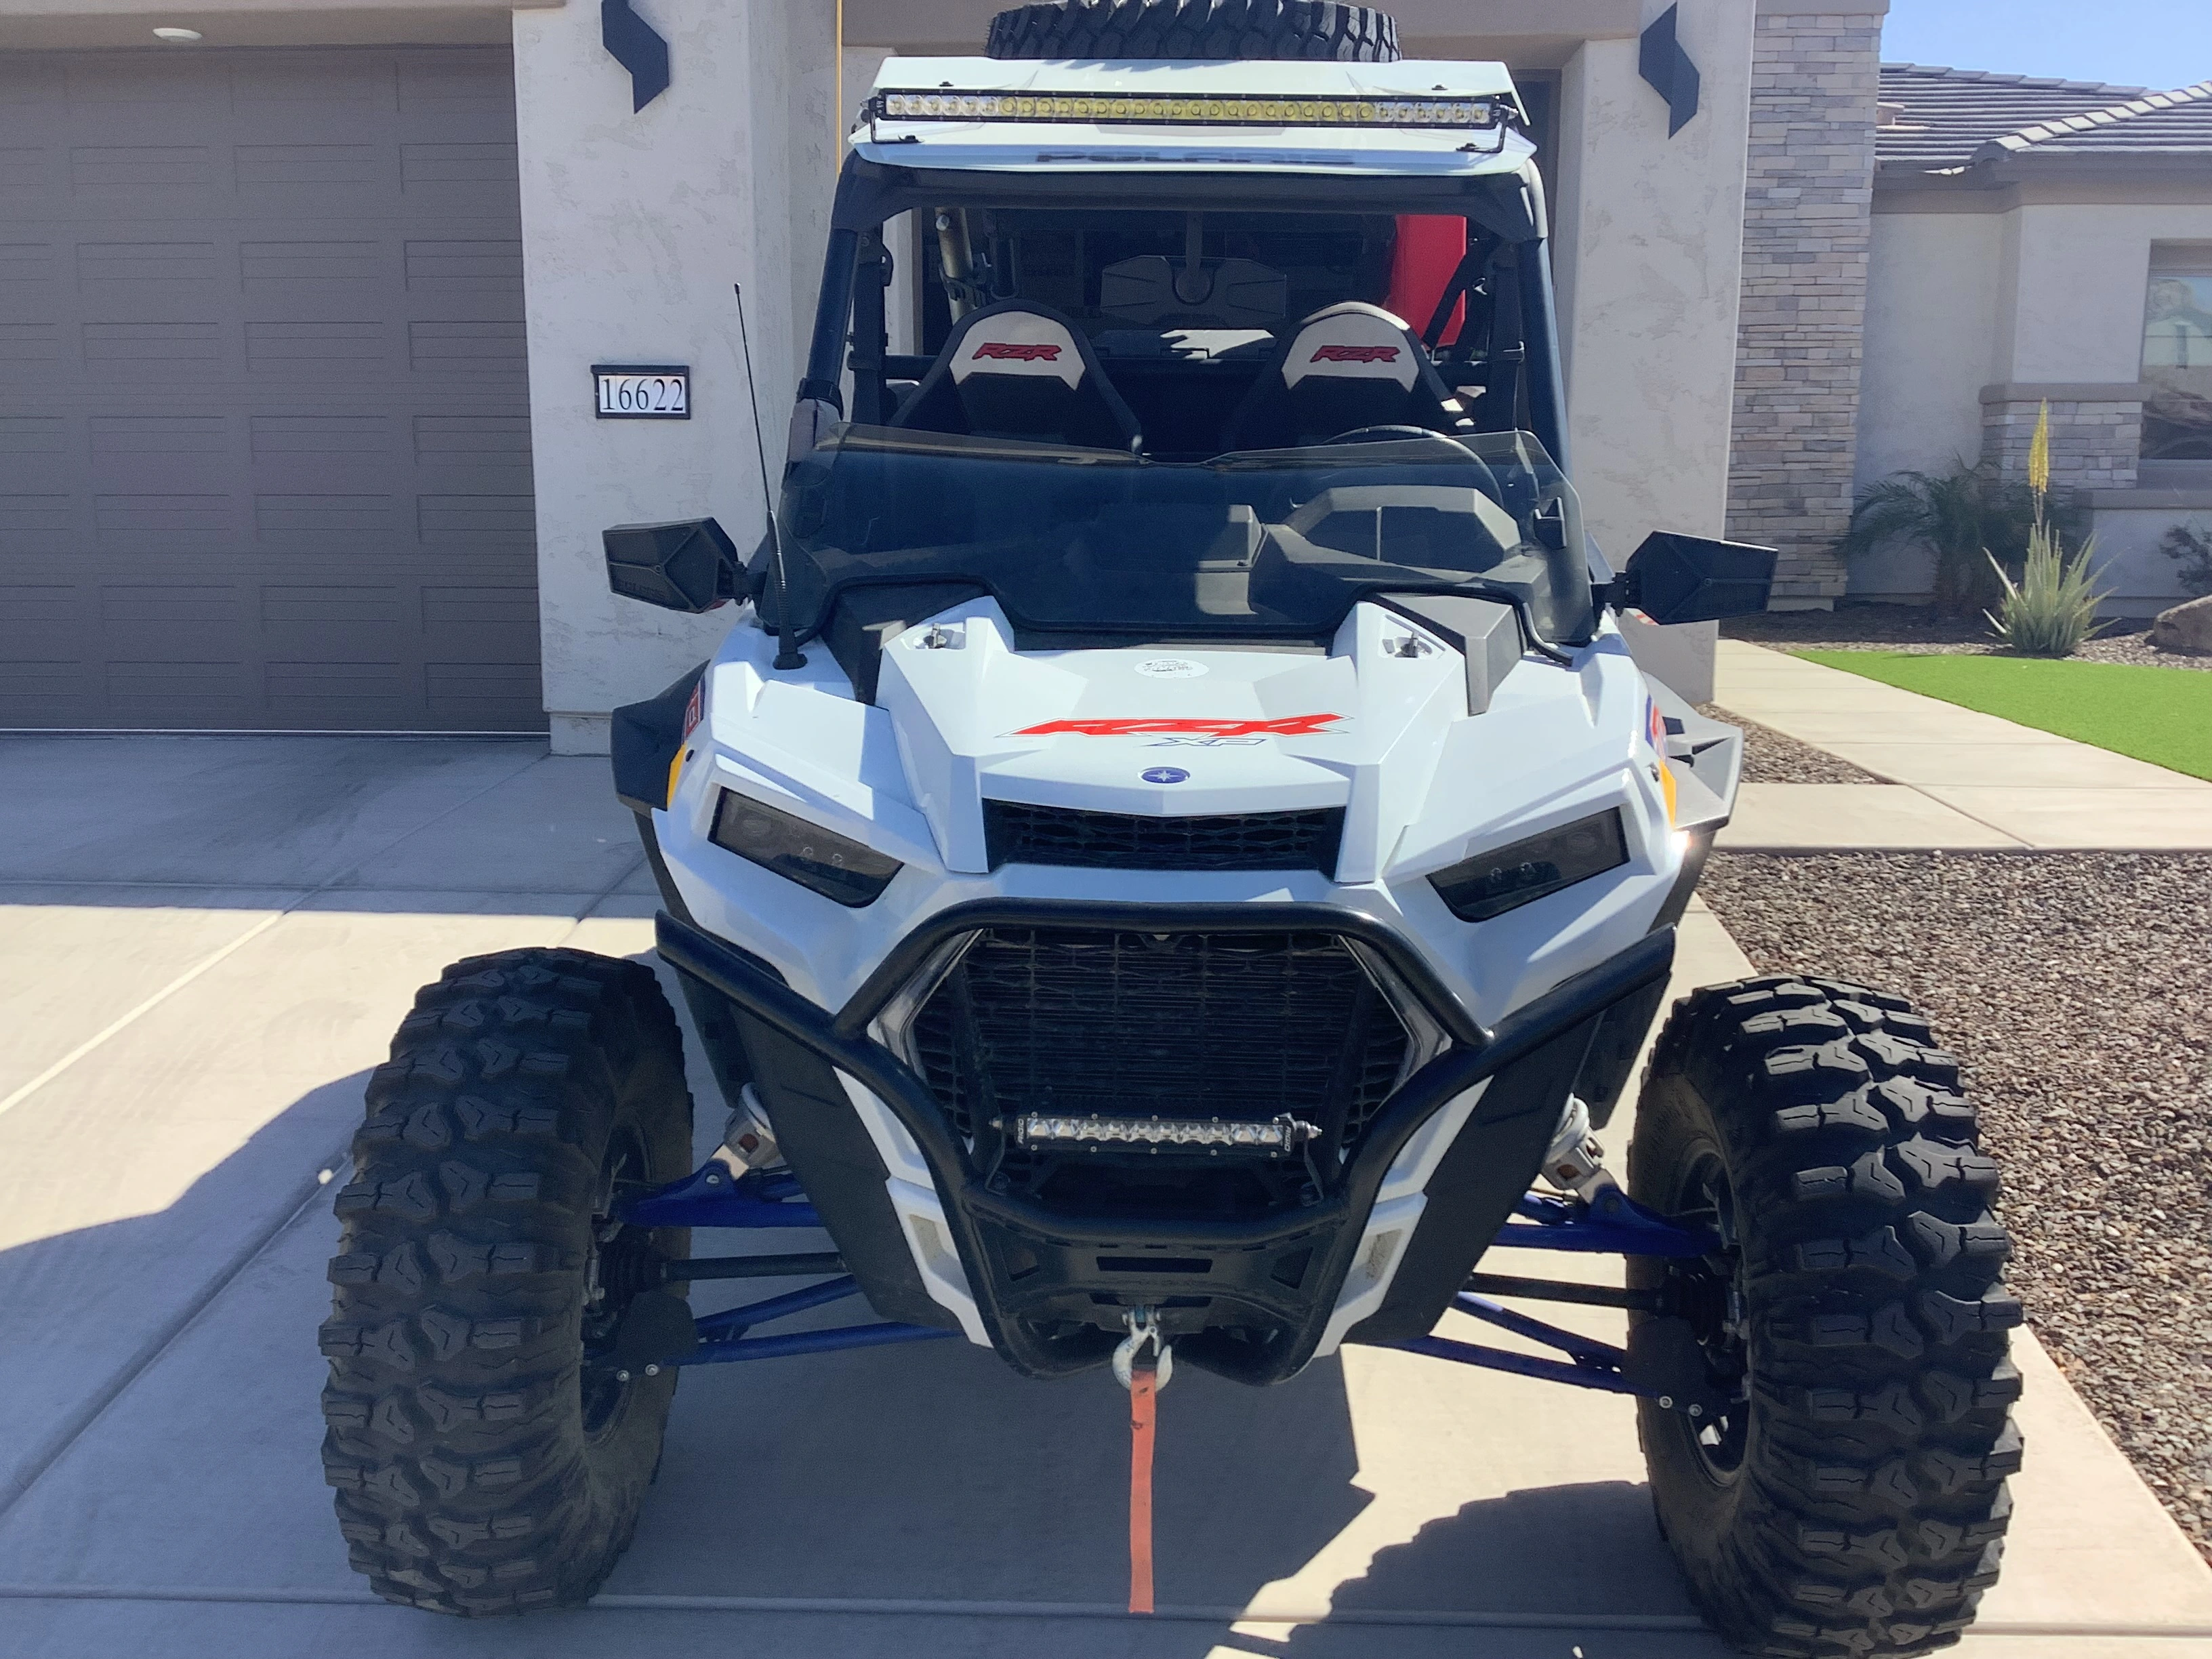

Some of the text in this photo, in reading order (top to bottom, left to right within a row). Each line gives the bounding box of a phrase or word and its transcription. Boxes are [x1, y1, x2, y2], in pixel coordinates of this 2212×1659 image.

[1036, 150, 1354, 165] POLARIS
[972, 342, 1062, 361] RZR
[1310, 345, 1401, 363] RZR
[601, 378, 684, 411] 16622
[996, 712, 1352, 737] RZR
[1145, 737, 1266, 746] XP
